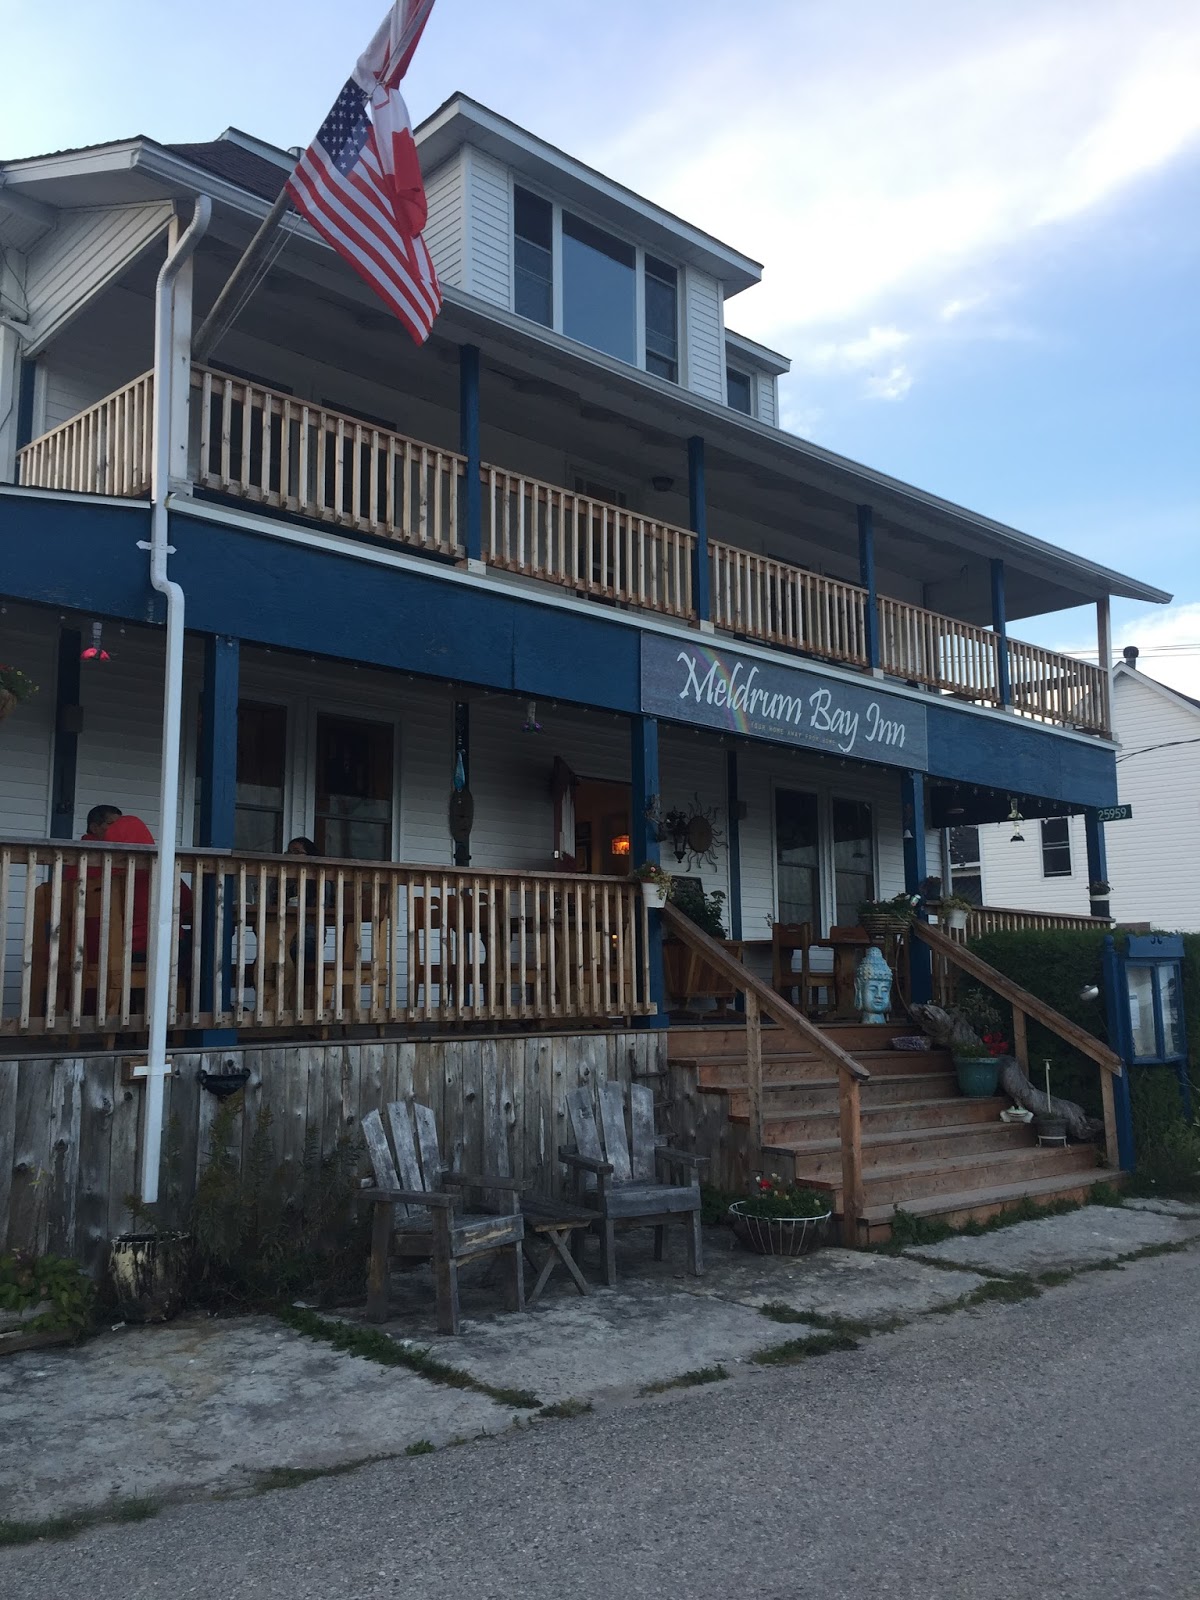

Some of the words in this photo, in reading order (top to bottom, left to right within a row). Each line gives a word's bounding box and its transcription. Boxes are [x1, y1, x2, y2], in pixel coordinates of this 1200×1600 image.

[677, 652, 802, 725] Meldrum
[809, 688, 859, 753] Bay
[865, 703, 906, 748] Inn
[1097, 807, 1127, 821] 25959
